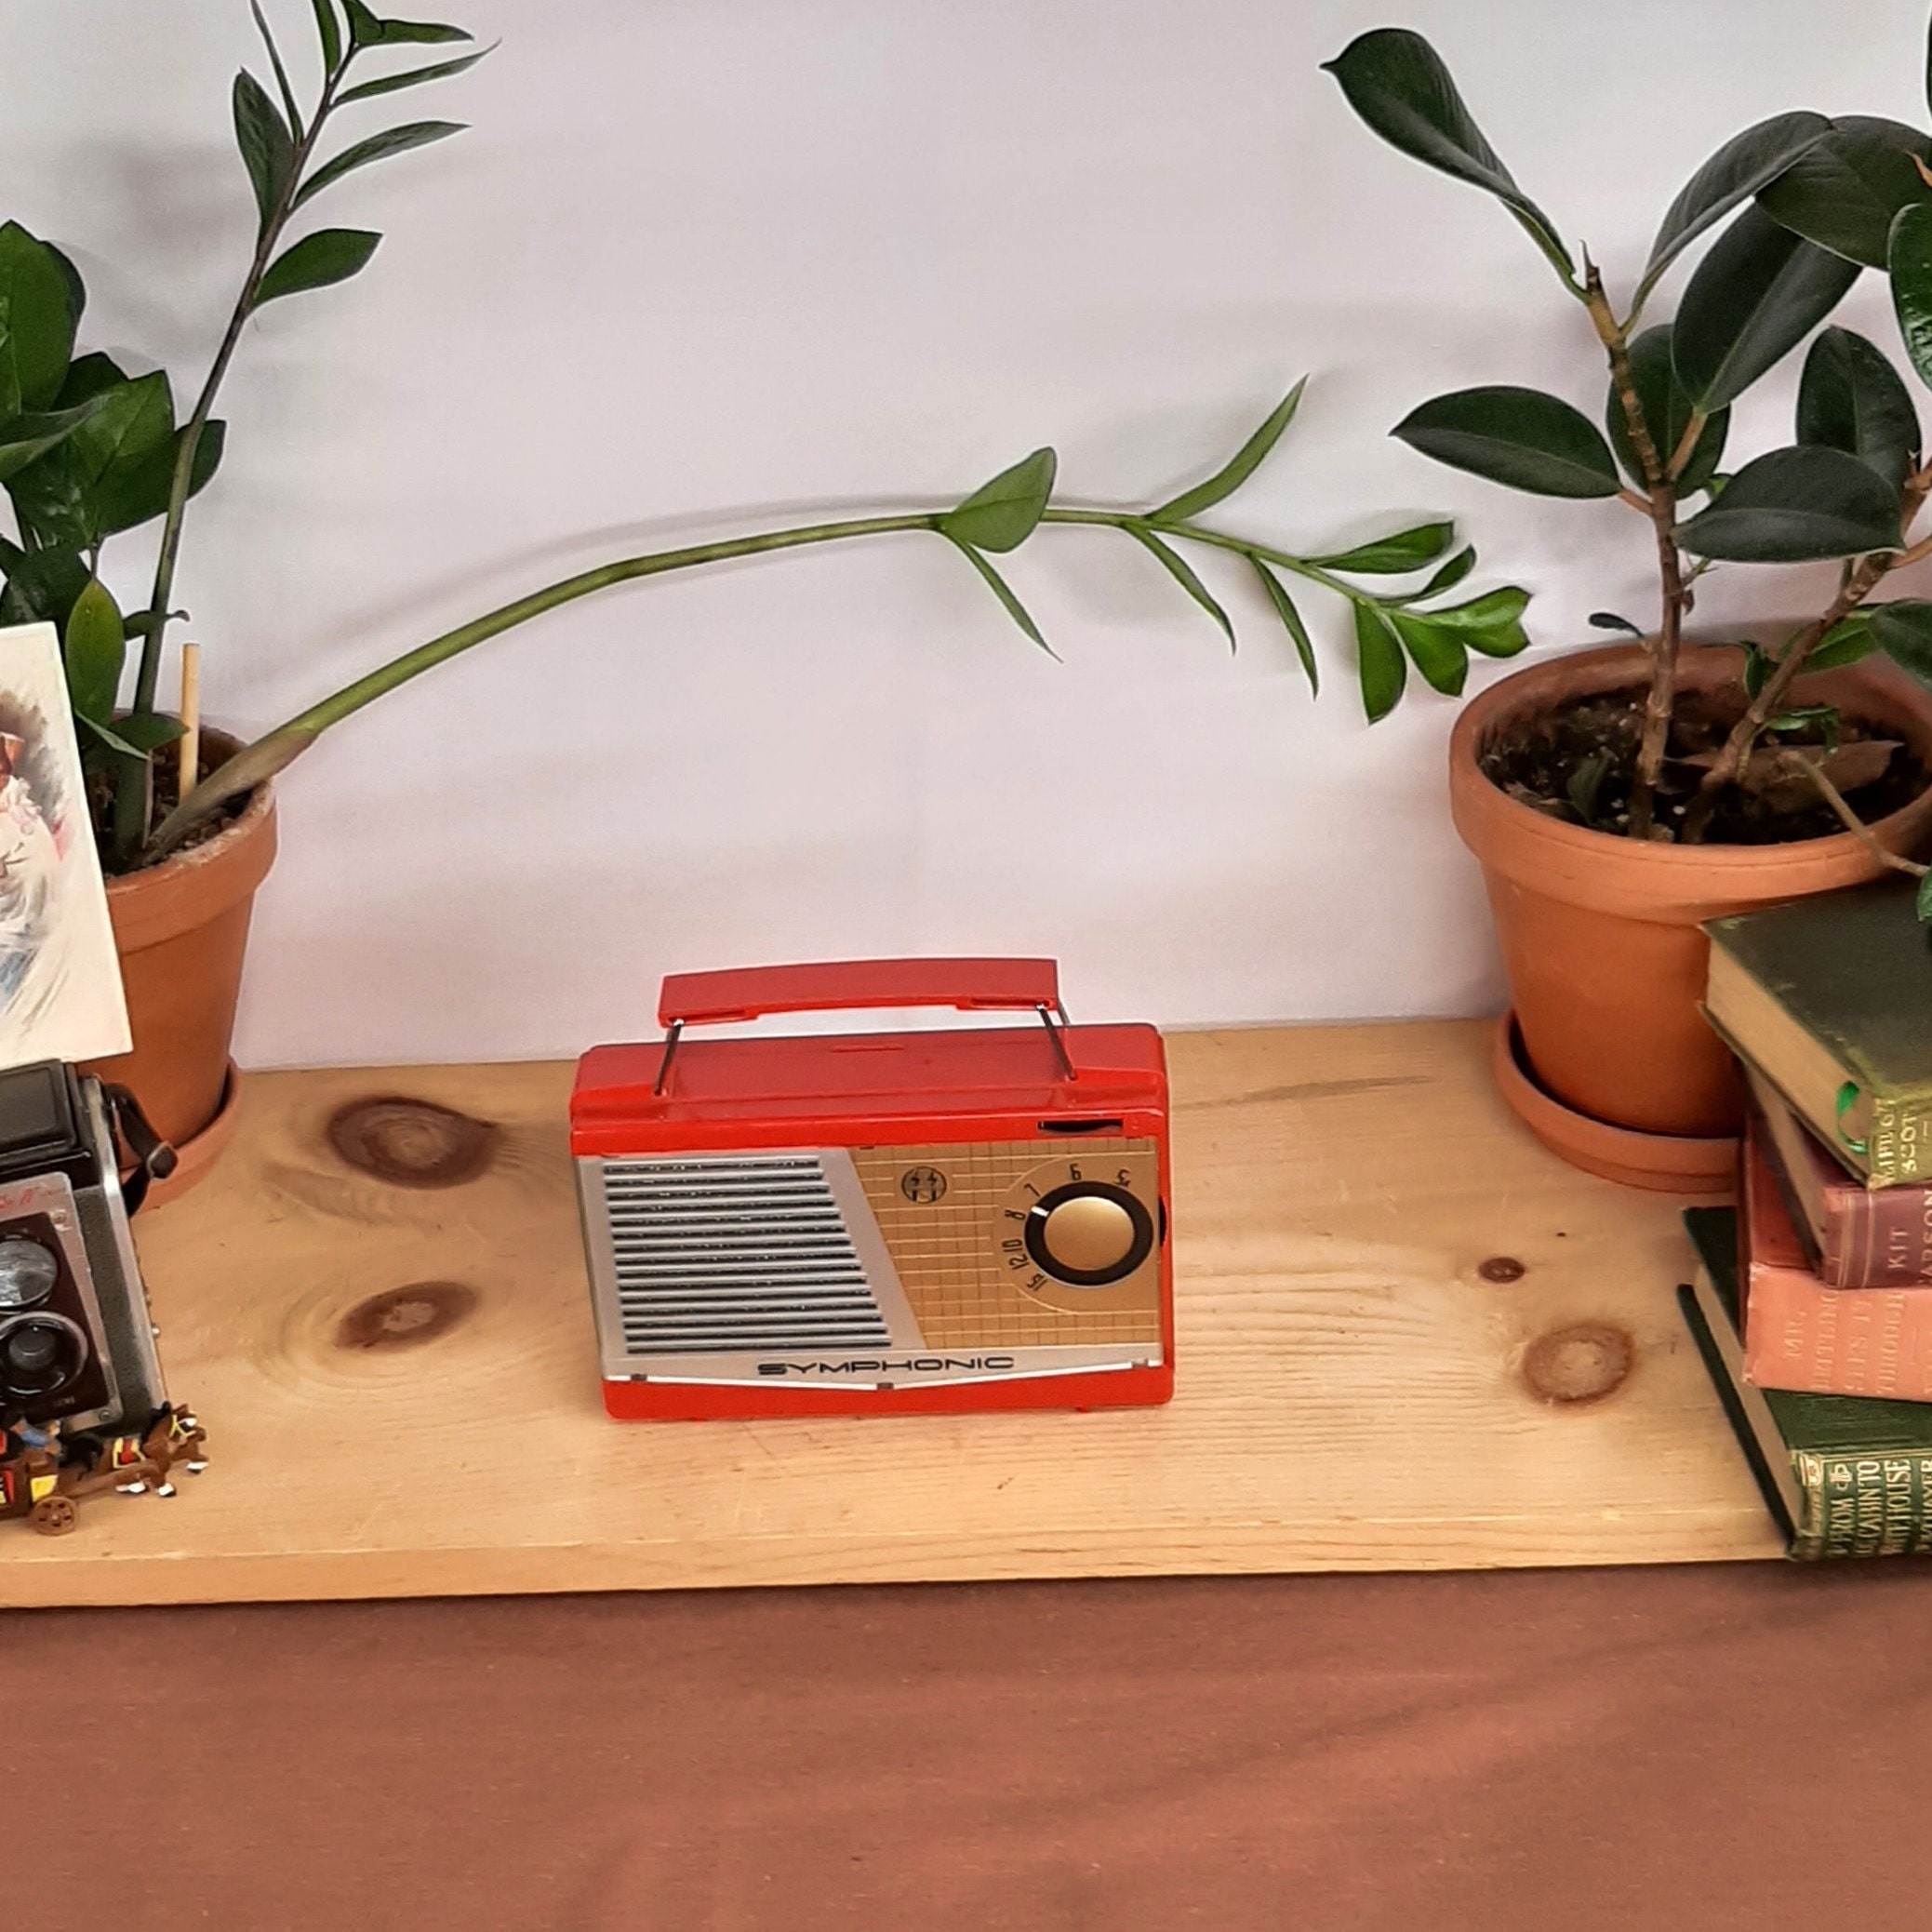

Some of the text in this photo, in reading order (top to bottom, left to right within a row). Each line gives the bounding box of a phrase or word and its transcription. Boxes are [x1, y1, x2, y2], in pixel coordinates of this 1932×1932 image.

[1070, 1164, 1082, 1181] 6
[1023, 1182, 1041, 1198] 7
[1004, 1209, 1026, 1221] 8
[1001, 1238, 1024, 1253] 10
[1887, 1227, 1909, 1268] KIT
[1008, 1254, 1030, 1271] 12
[757, 1356, 1015, 1376] SYMPHONIC
[1856, 1460, 1882, 1486] TO
[1884, 1459, 1912, 1521] HOUSE
[1829, 1498, 1856, 1542] FROM
[1857, 1488, 1883, 1539] CABIN
